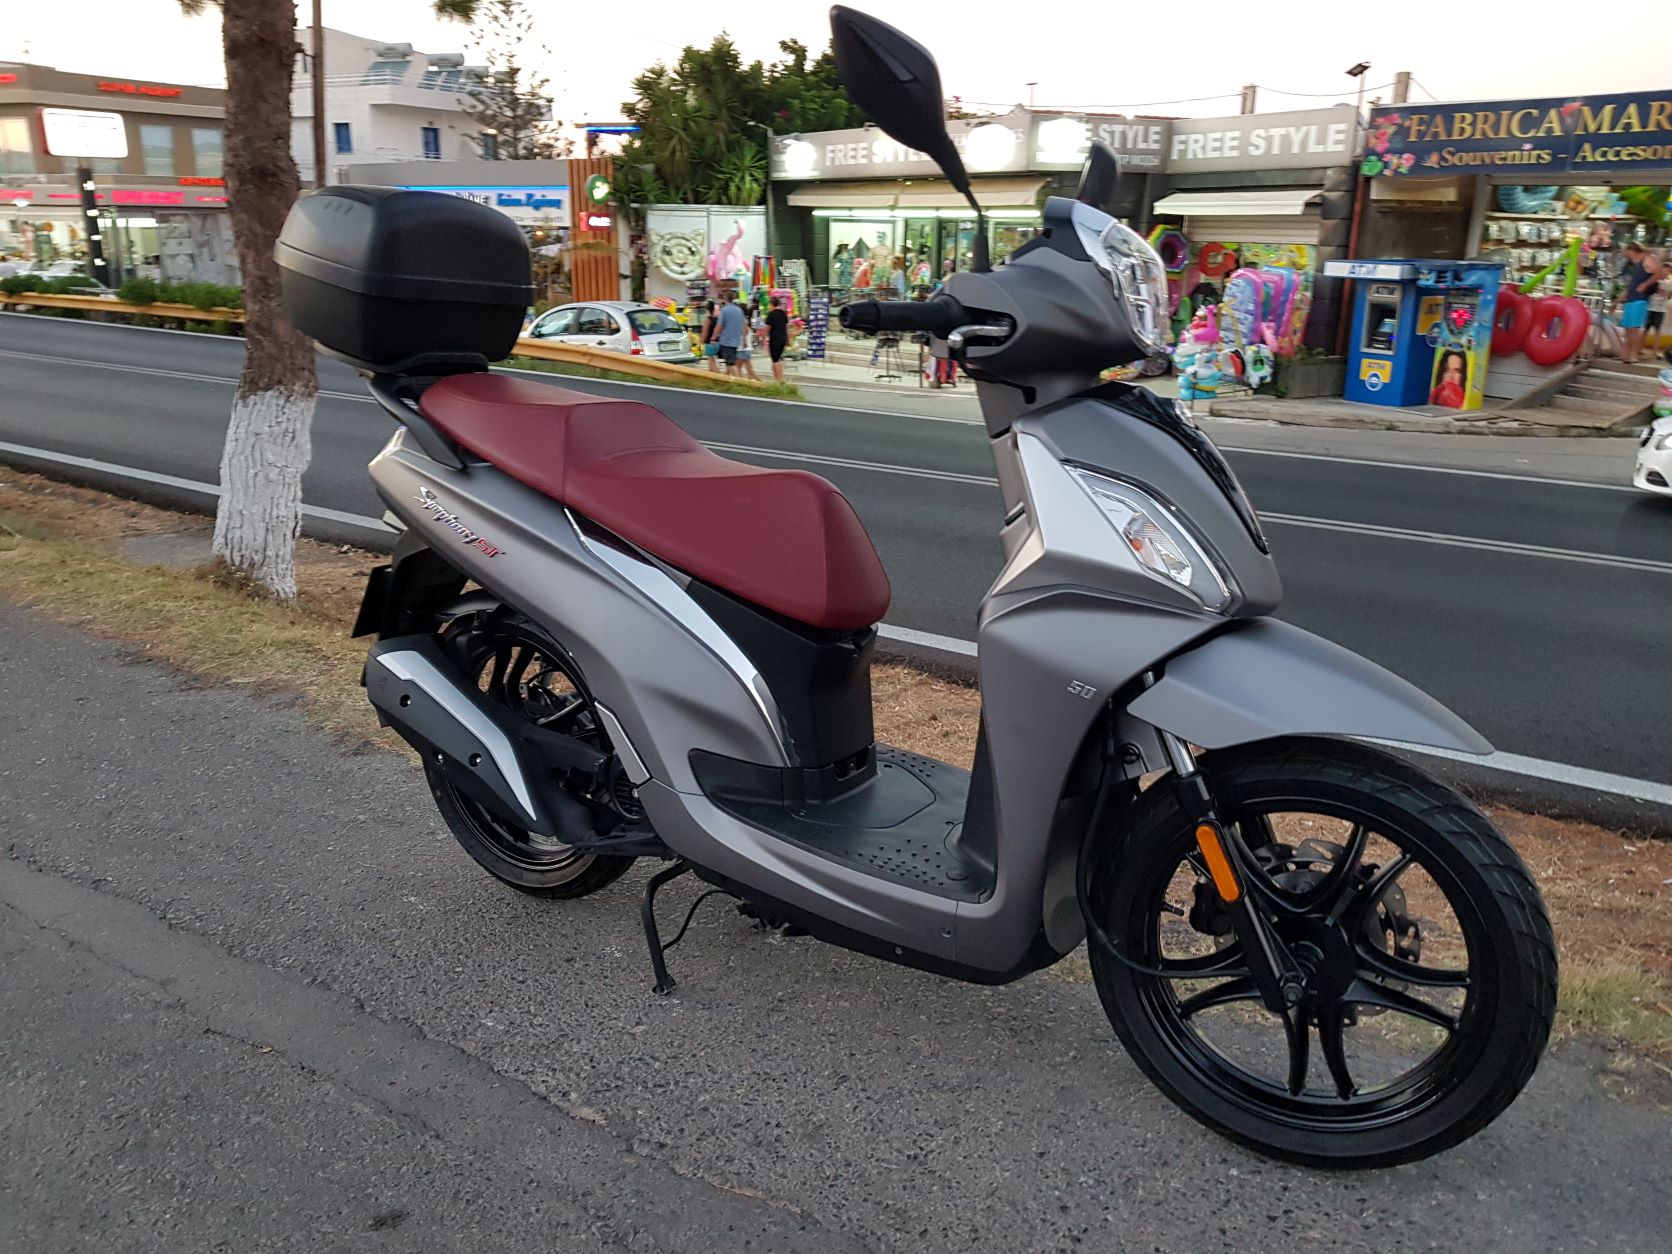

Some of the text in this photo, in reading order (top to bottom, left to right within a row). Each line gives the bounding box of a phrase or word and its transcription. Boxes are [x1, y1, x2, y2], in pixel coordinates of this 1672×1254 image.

[1098, 123, 1162, 150] STYLE
[1407, 109, 1564, 141] FABRICA
[1171, 123, 1349, 160] FREE STYLE
[825, 143, 868, 166] FREE
[1440, 146, 1552, 165] Souvenirs
[1427, 304, 1443, 315] AT
